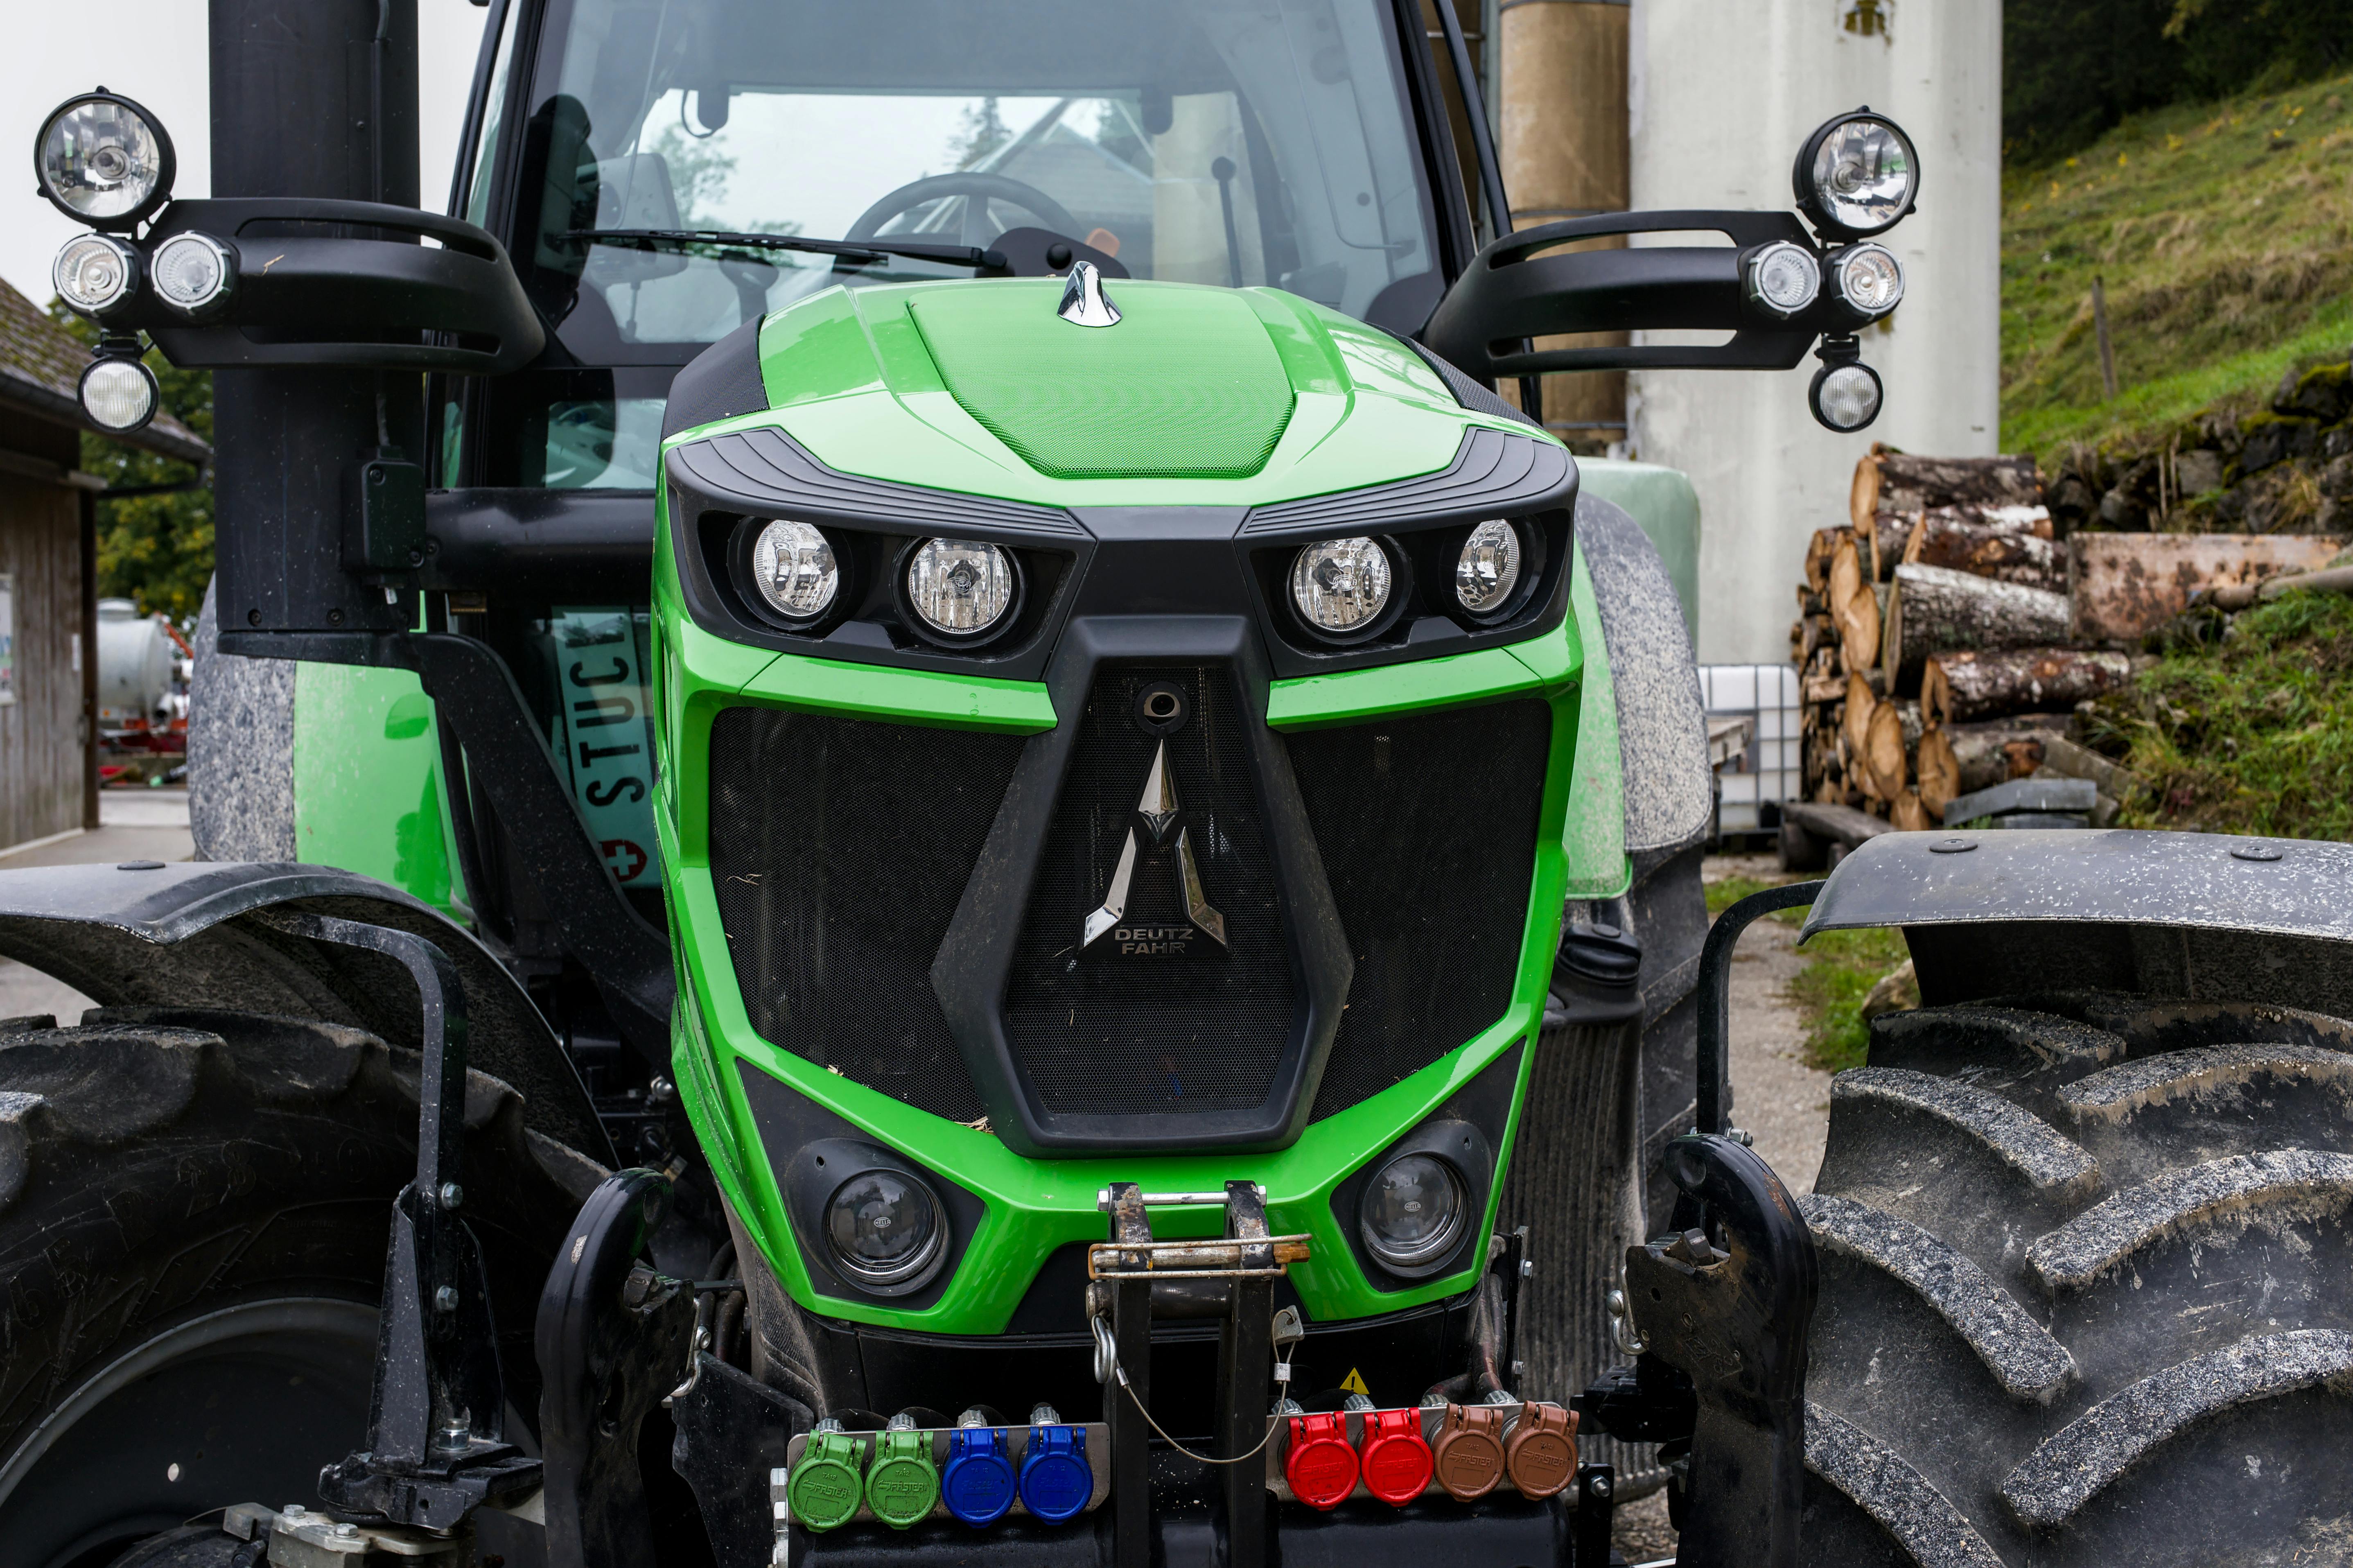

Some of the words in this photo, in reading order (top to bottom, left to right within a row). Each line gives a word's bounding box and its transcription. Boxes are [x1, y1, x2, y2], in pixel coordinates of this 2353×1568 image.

[1115, 928, 1193, 941] DEUTZ
[1122, 942, 1185, 954] FAHR
[864, 1263, 905, 1273] Bi-Halogen
[1466, 1442, 1481, 1451] TA12
[822, 1472, 838, 1481] TA12
